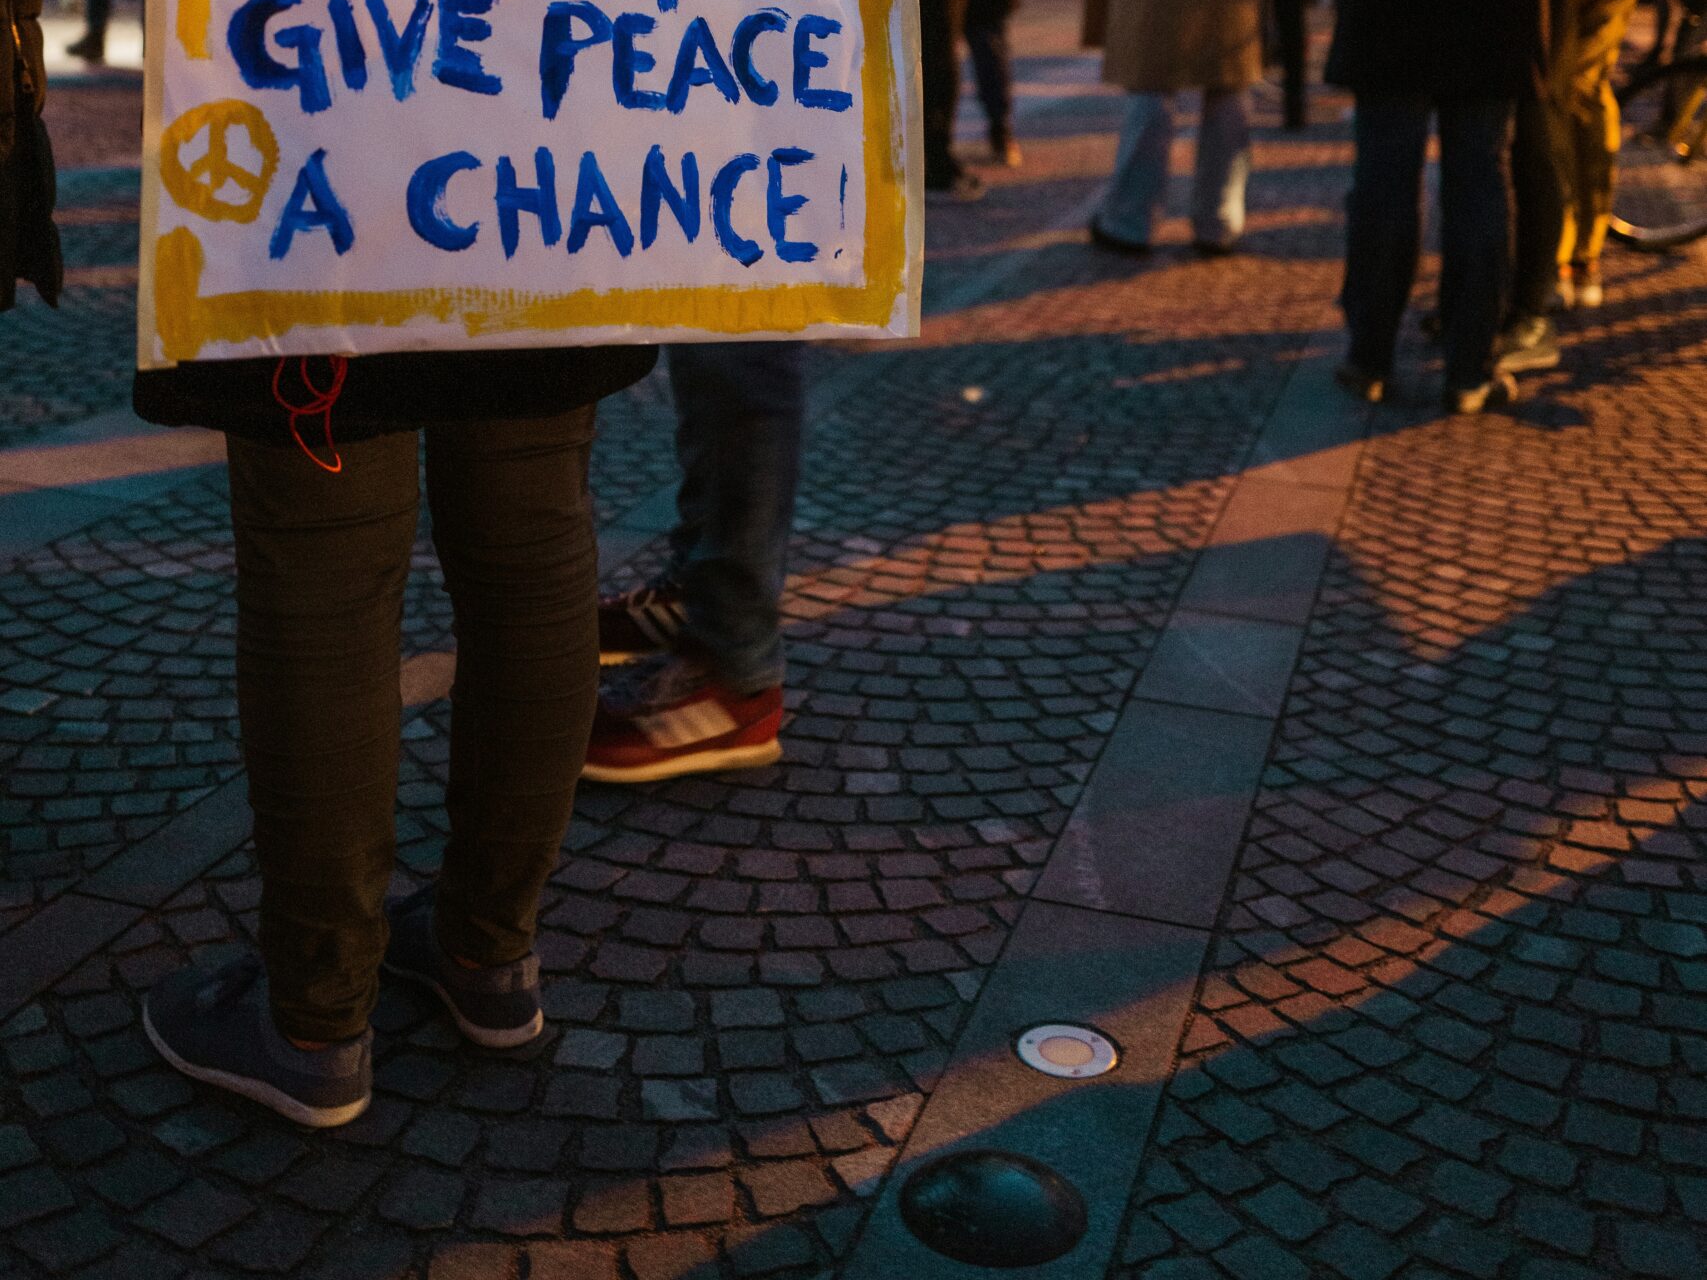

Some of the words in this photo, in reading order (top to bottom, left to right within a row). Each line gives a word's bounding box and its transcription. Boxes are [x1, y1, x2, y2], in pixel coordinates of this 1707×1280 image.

[538, 0, 853, 120] PEACE
[269, 148, 356, 261] A
[406, 143, 849, 268] CHANCE!
